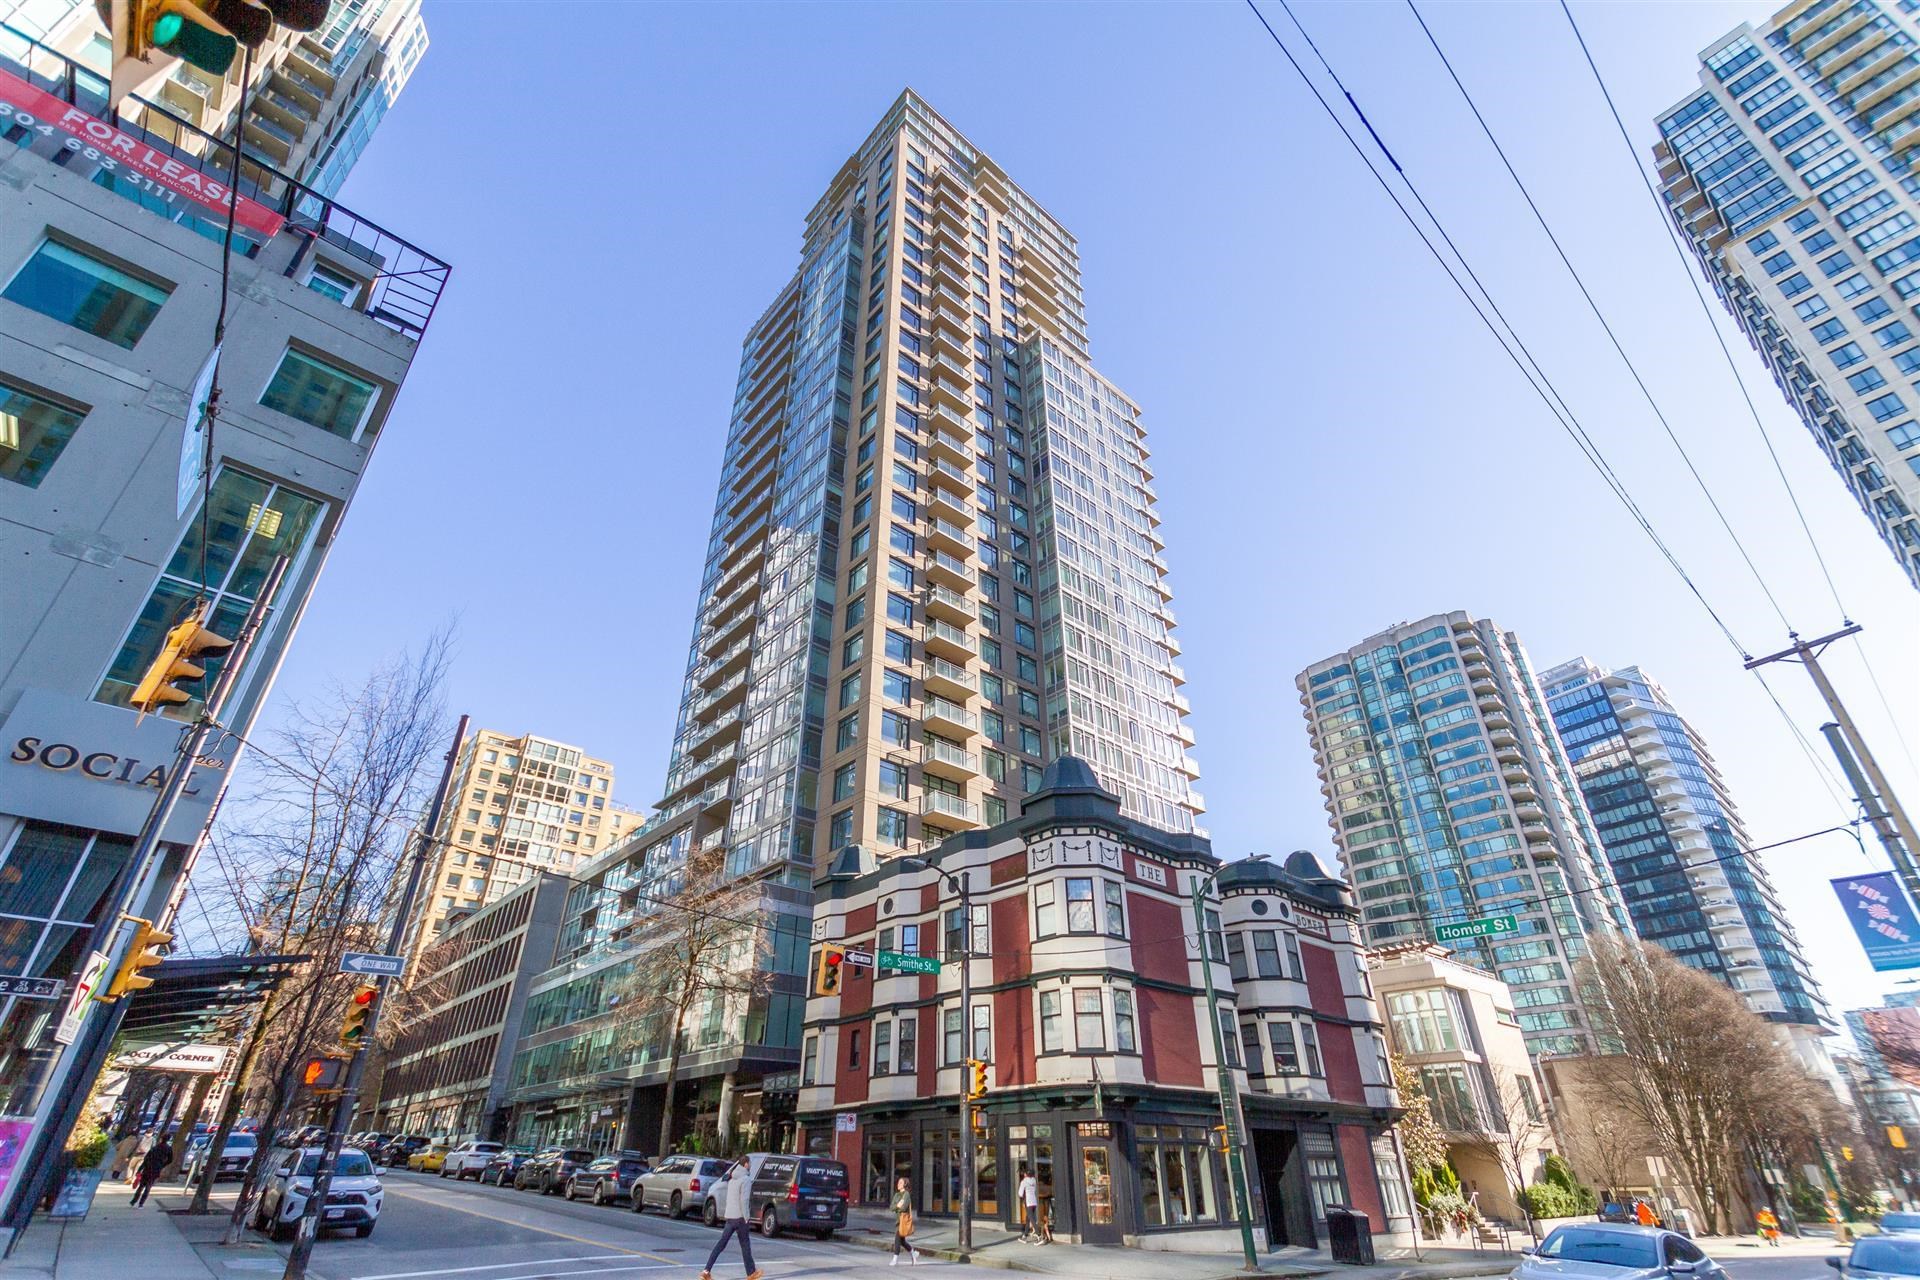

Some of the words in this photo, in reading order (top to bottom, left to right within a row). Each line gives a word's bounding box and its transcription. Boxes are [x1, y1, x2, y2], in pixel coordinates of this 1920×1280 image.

[0, 102, 54, 136] 604
[65, 137, 118, 170] 683
[125, 170, 177, 203] 3111
[62, 108, 136, 154] FOR
[142, 151, 244, 210] LEASE
[79, 131, 113, 152] HOMER
[155, 172, 210, 203] VANCOUVER
[10, 736, 201, 796] SOCIAL
[1139, 863, 1162, 882] THE
[1295, 914, 1324, 933] HOMER
[1441, 924, 1487, 939] Homer
[1493, 918, 1511, 931] St
[361, 960, 376, 968] ONE
[379, 961, 396, 970] WAY
[897, 957, 923, 970] Smithe
[924, 961, 935, 971] St.
[169, 1053, 215, 1062] CORNER
[806, 1167, 825, 1175] WATT
